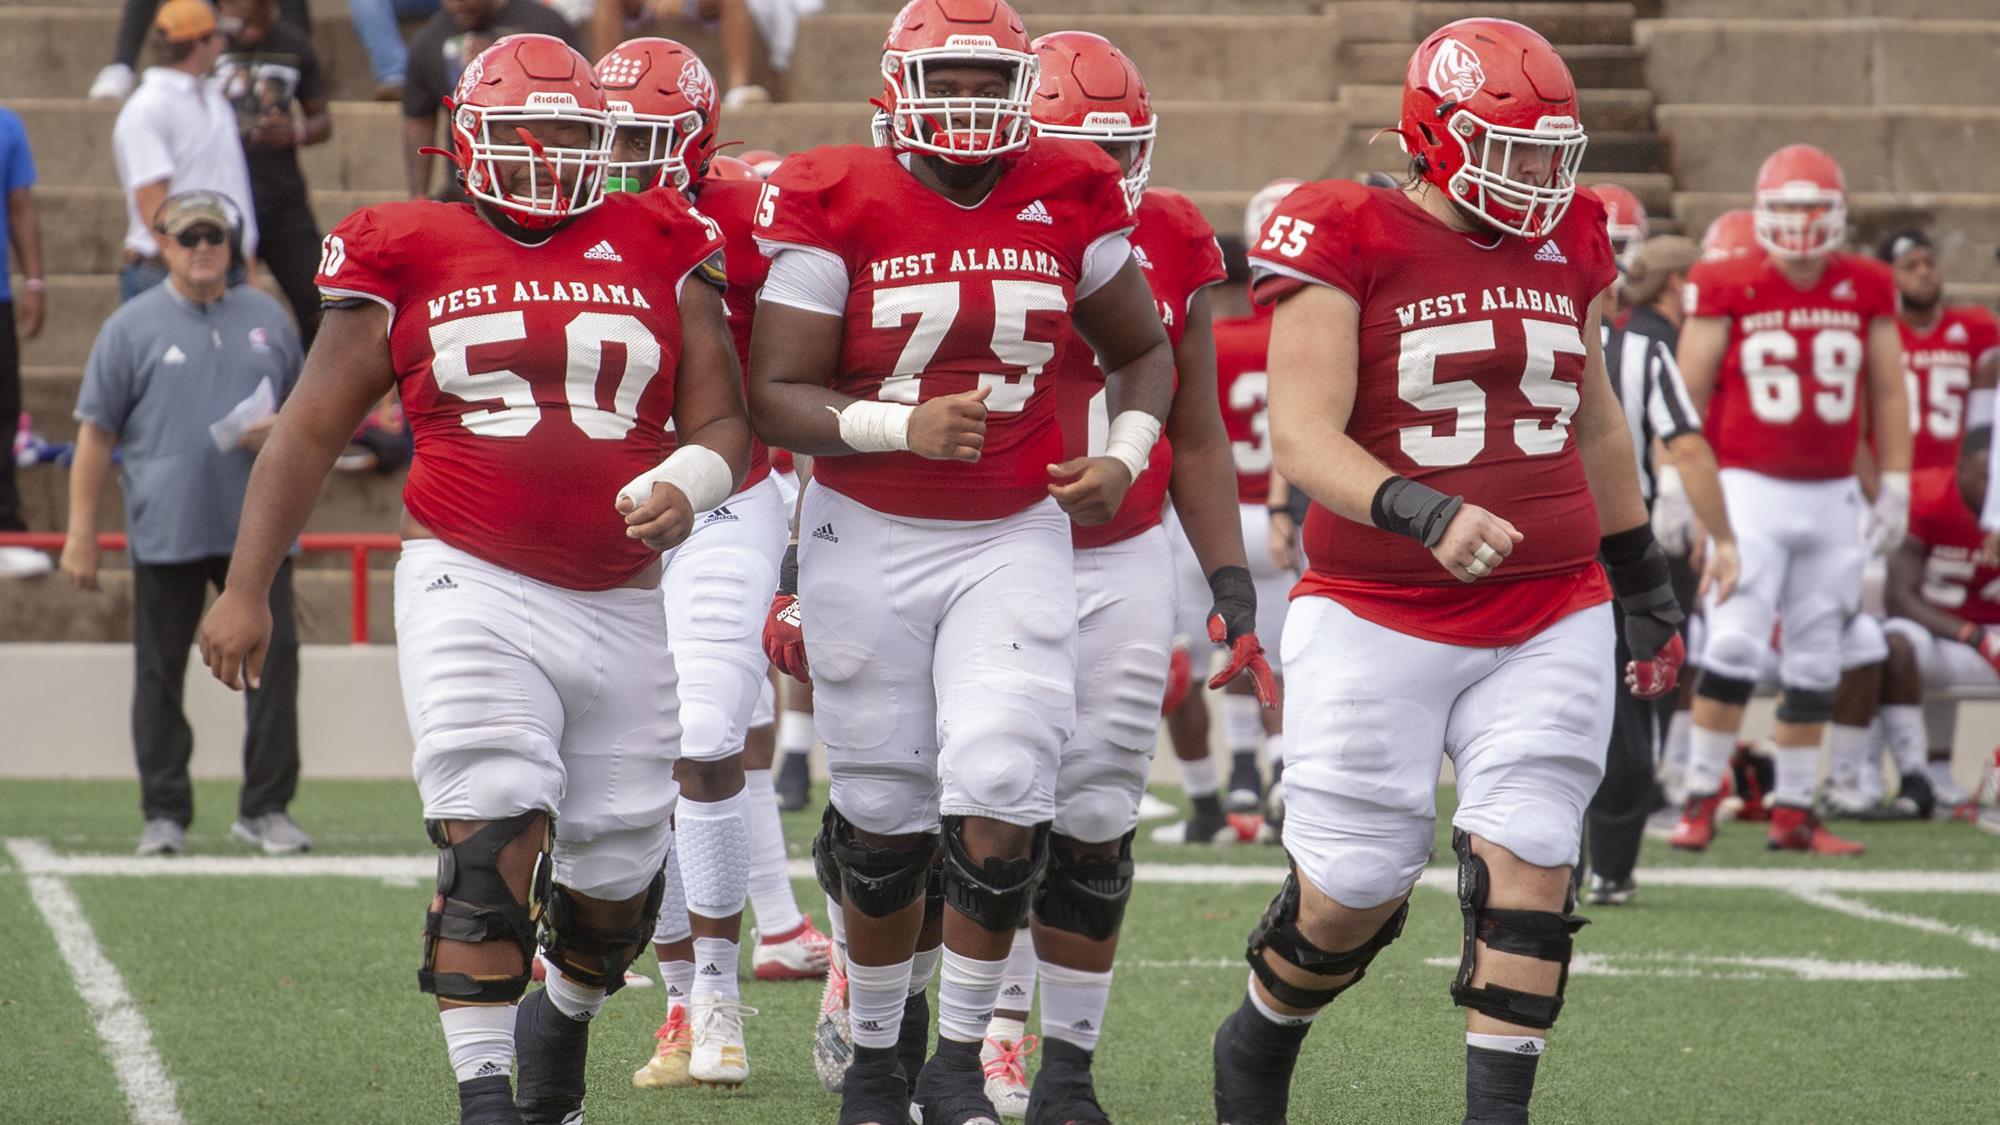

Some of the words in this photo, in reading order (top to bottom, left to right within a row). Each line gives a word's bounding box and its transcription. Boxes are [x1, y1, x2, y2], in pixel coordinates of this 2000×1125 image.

[534, 95, 573, 104] Riddell
[1016, 212, 1053, 225] adidas
[1261, 215, 1315, 257] 55
[583, 251, 623, 262] adidas
[871, 252, 936, 282] WEST
[950, 248, 1060, 277] ALABAMA
[1534, 253, 1568, 264] adidas
[427, 284, 498, 319] WEST
[513, 280, 650, 309] ALABAMA
[1396, 292, 1467, 327] WEST
[872, 280, 1068, 412] 75
[428, 310, 661, 440] 50
[1740, 328, 1863, 424] 69
[1398, 318, 1587, 467] 55
[812, 530, 839, 543] adidas
[776, 600, 801, 622] didas
